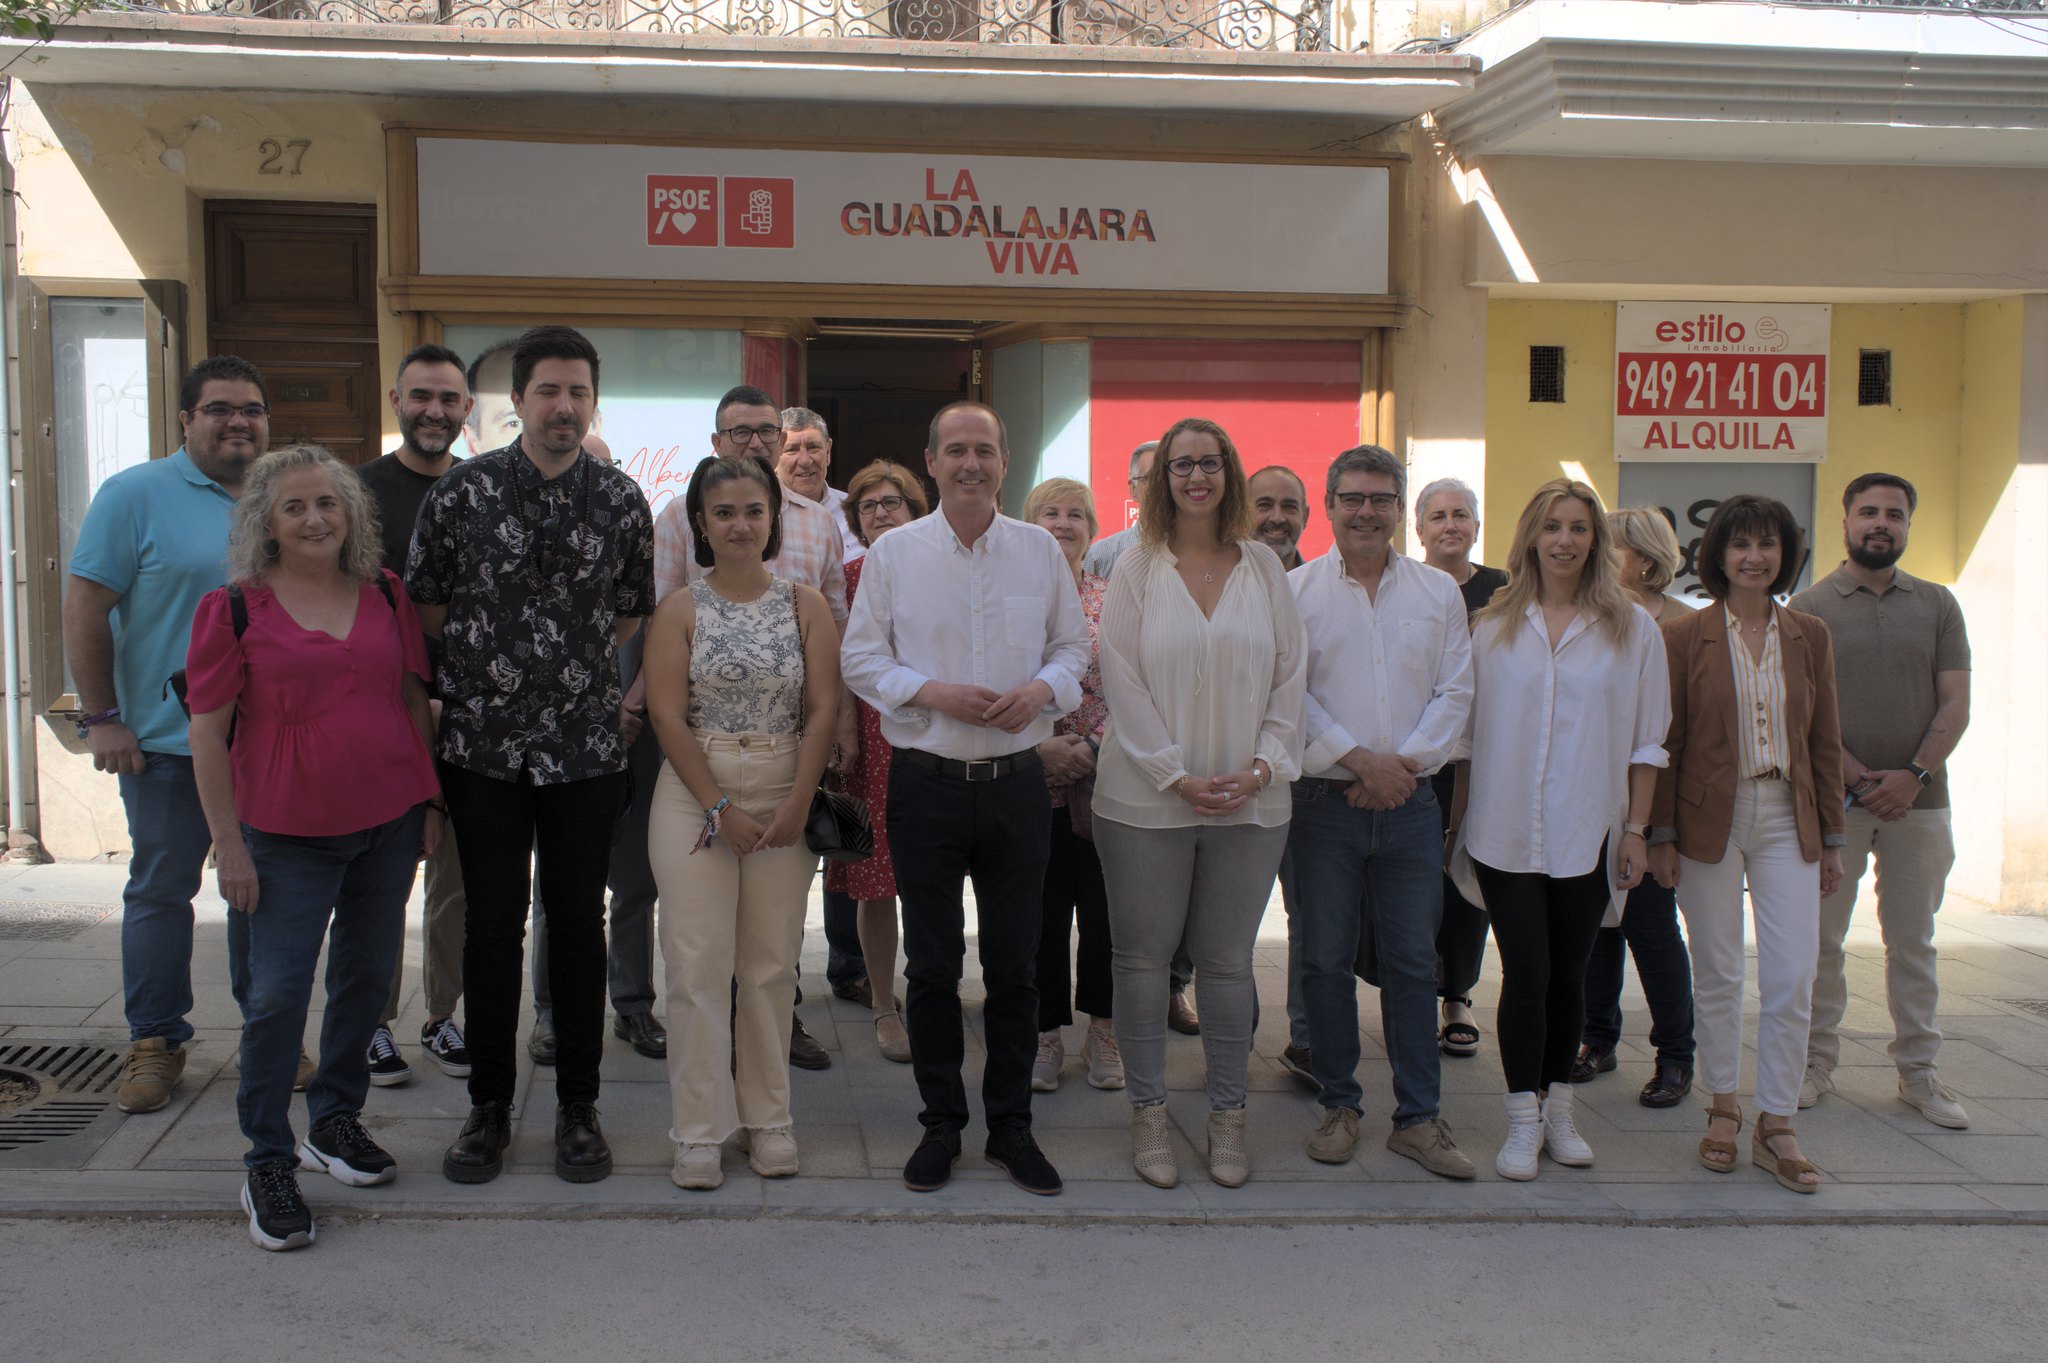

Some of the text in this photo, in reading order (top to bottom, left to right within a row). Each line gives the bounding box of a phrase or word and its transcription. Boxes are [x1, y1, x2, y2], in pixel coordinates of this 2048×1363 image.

[258, 138, 312, 175] 27
[654, 188, 711, 210] PSOE
[925, 168, 980, 202] LA
[840, 201, 1157, 242] GUADALAJARA
[985, 241, 1080, 275] VIVA
[1655, 314, 1746, 343] estilo
[1687, 344, 1777, 353] inmobiliaria
[1625, 360, 1818, 411] 949 21 41 04
[1643, 421, 1796, 450] ALQUILA
